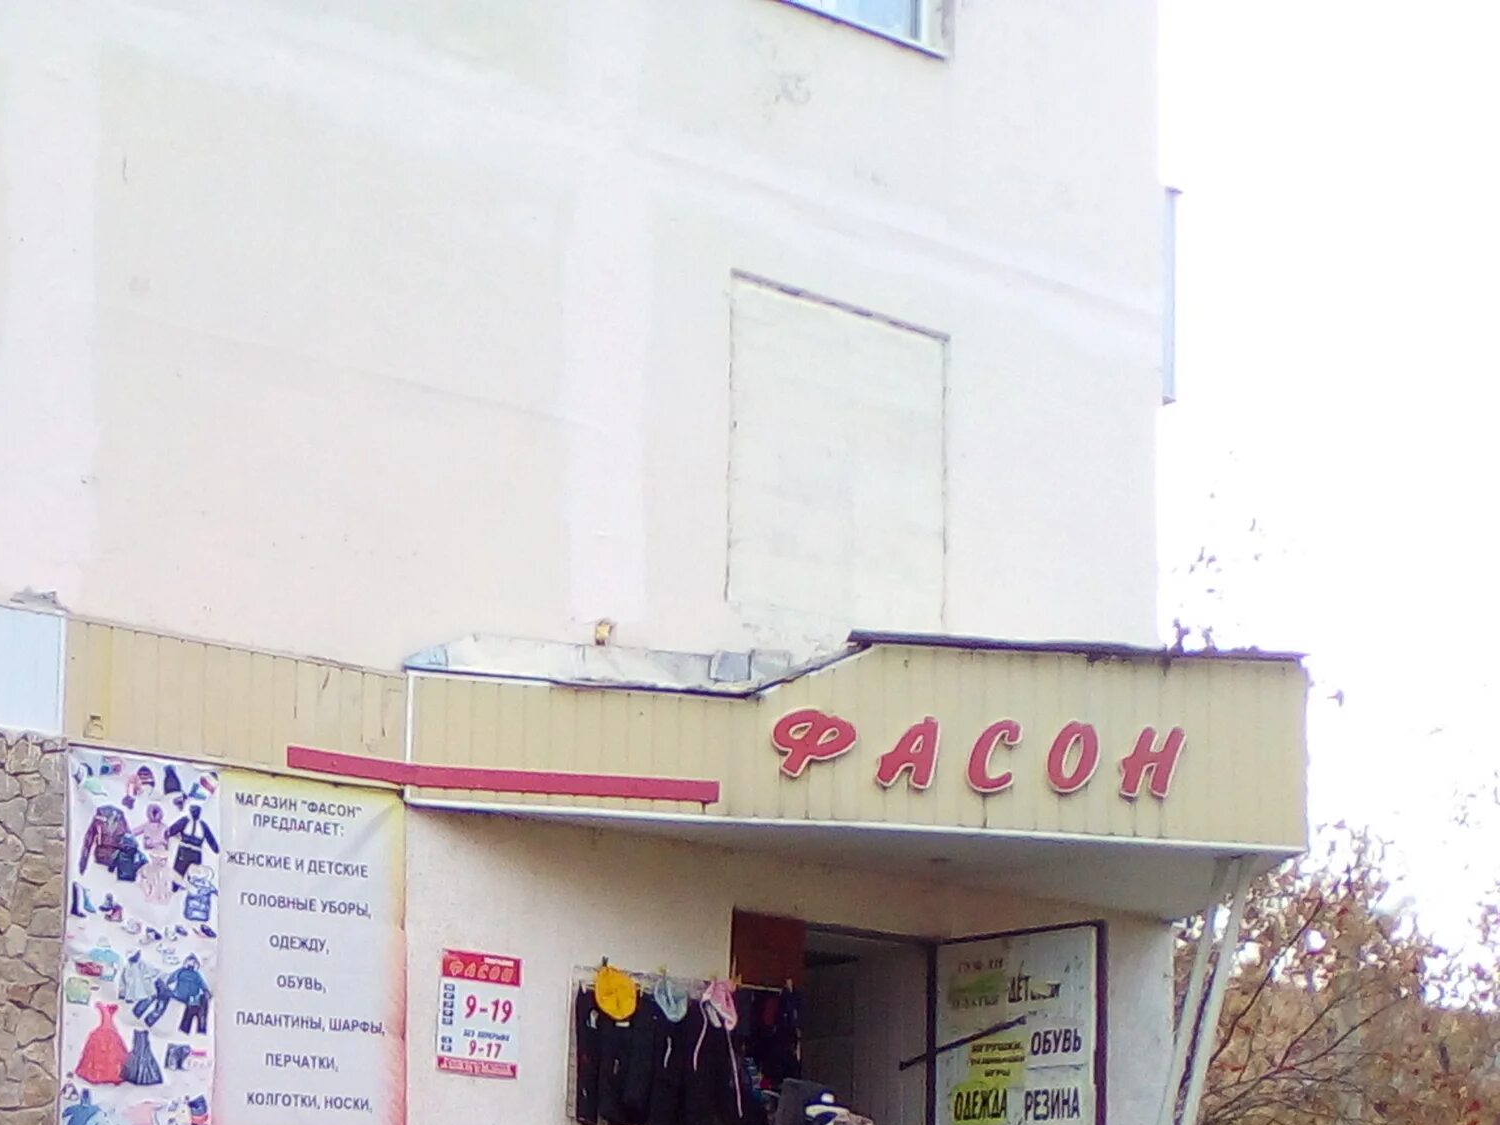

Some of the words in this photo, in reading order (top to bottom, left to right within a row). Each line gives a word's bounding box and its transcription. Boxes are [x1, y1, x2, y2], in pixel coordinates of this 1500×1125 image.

[771, 707, 1188, 800] ФАСОН
[235, 792, 297, 812] МАГАЗИН
[301, 800, 363, 818] "ФАСОН"
[252, 813, 345, 837] ПРЕДЛАГАЕТ:
[226, 851, 292, 871] ЖЕНСКИЕ
[295, 859, 305, 871] И
[307, 859, 369, 879] ДЕТСКИЕ
[240, 891, 317, 913] ГОЛОВНЫЕ
[321, 899, 372, 919] УБОРЫ,
[269, 935, 330, 954] ОДЕЖДУ,
[276, 974, 327, 994] ОБУВЬ,
[464, 994, 513, 1024] 9-19
[236, 1011, 325, 1033] ПАЛАНТИНЫ,
[329, 1017, 386, 1037] ШАРФЫ,
[468, 1039, 502, 1059] 9-17
[1030, 1028, 1083, 1056] ОБУВЬ
[265, 1052, 339, 1072] ПЕРЧАТКИ,
[246, 1092, 320, 1110] КОЛГОТКИ,
[324, 1096, 372, 1114] НОСКИ,
[953, 1088, 1008, 1121] ОДЕЖДА
[1024, 1087, 1081, 1122] РЕЗИНА
